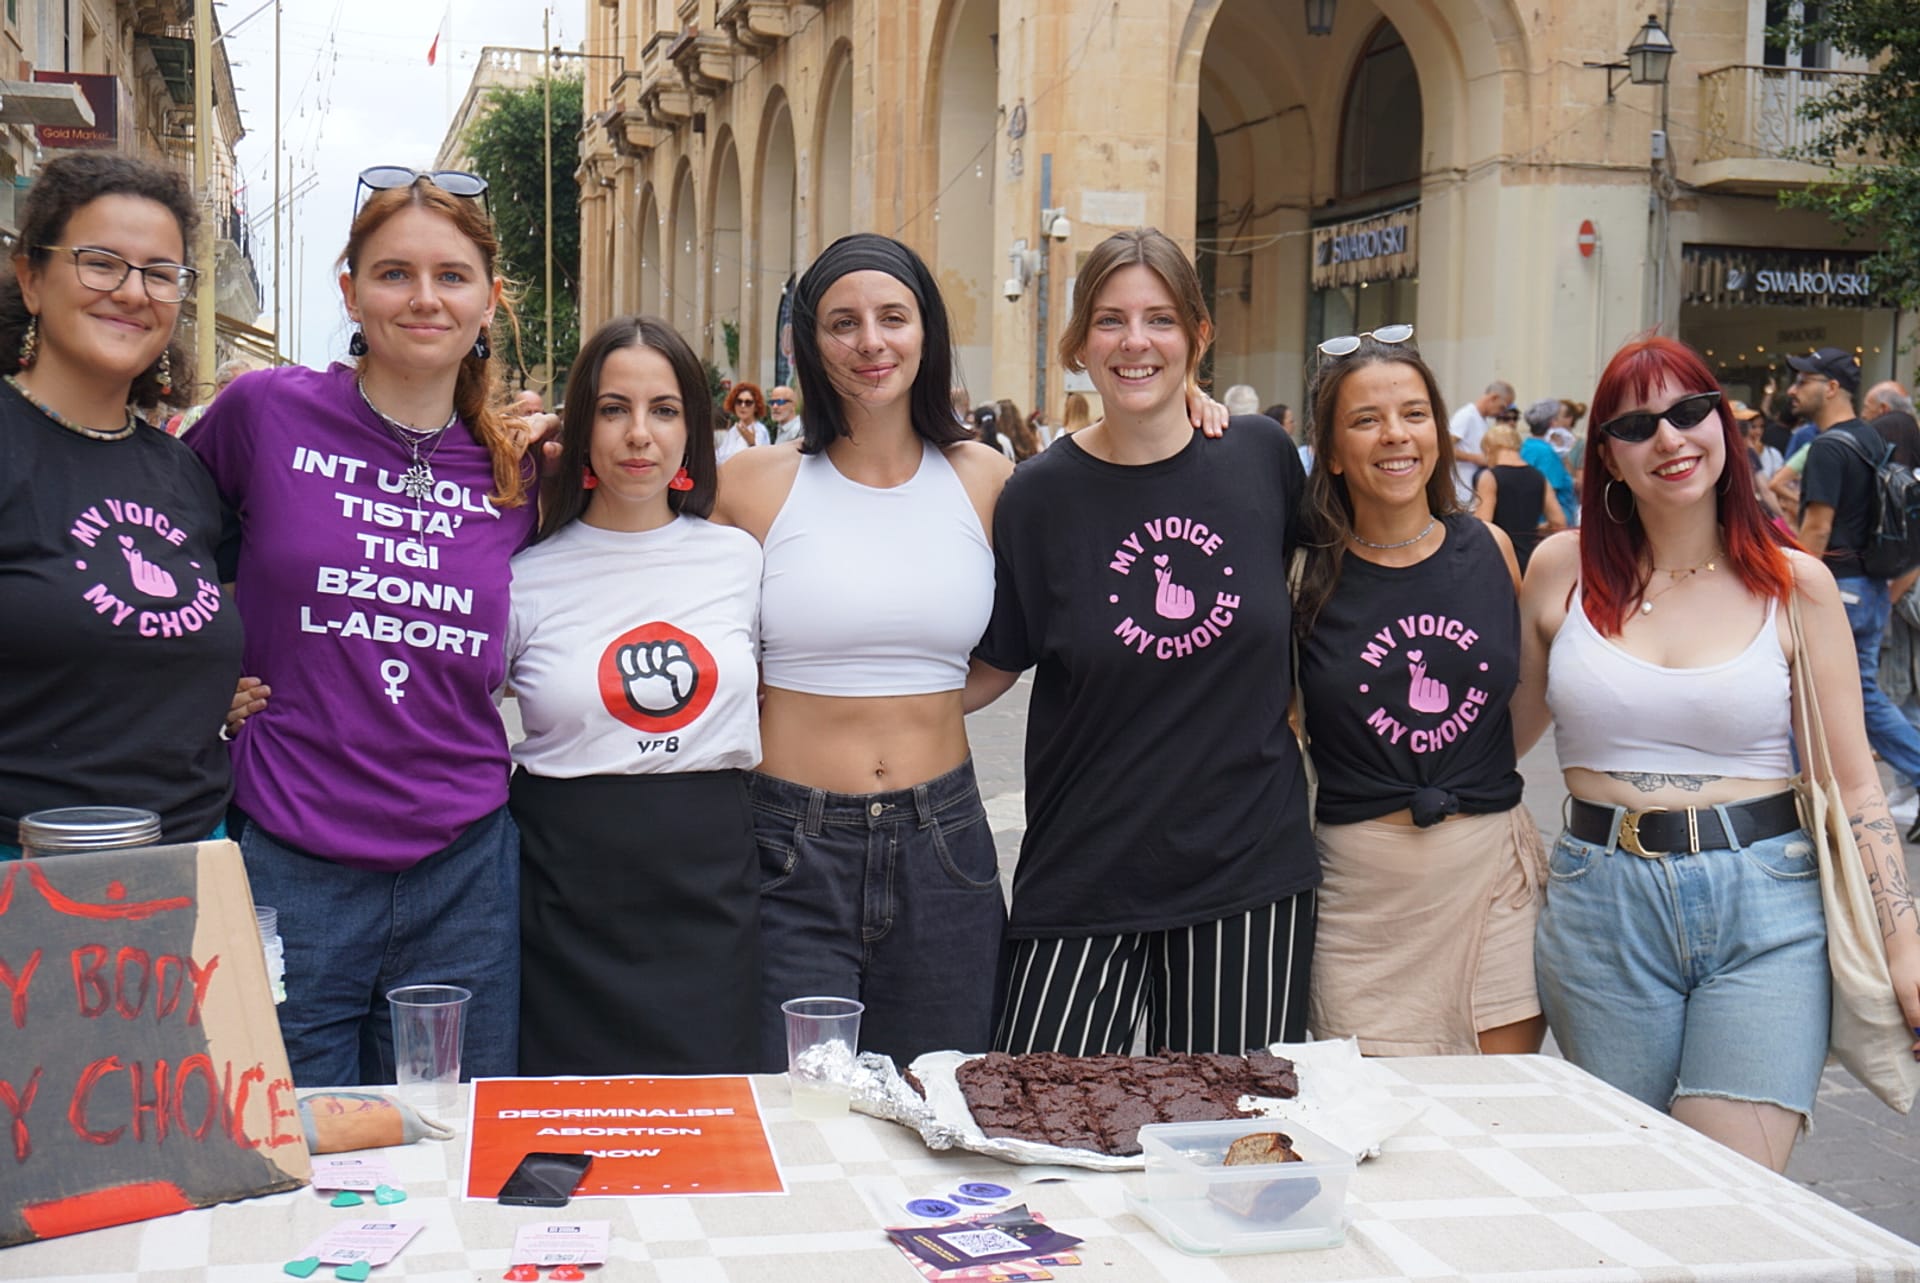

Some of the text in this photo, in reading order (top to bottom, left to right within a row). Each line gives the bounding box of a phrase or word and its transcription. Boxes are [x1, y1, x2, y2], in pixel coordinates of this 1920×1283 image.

[42, 128, 70, 138] Gold
[1332, 225, 1405, 264] SWAROVSKI
[1756, 270, 1870, 295] SWAROVSKI
[292, 446, 367, 484] INT
[70, 499, 187, 548] MY VOICE
[1109, 516, 1224, 576] MY VOICE
[357, 533, 438, 570] TIĠI
[82, 578, 220, 638] MY CHOICE
[317, 566, 473, 614] BŻONN
[301, 606, 488, 657] L-ABORT
[1113, 591, 1240, 660] MY CHOICE
[1360, 614, 1479, 668] MY VOICE
[1366, 687, 1488, 753] MY CHOICE
[71, 944, 219, 1026] BODY
[68, 1053, 301, 1149] CHOICE
[498, 1108, 735, 1119] DECRIMINALISE
[536, 1127, 702, 1136] ABORTION
[583, 1149, 661, 1158] NOW
